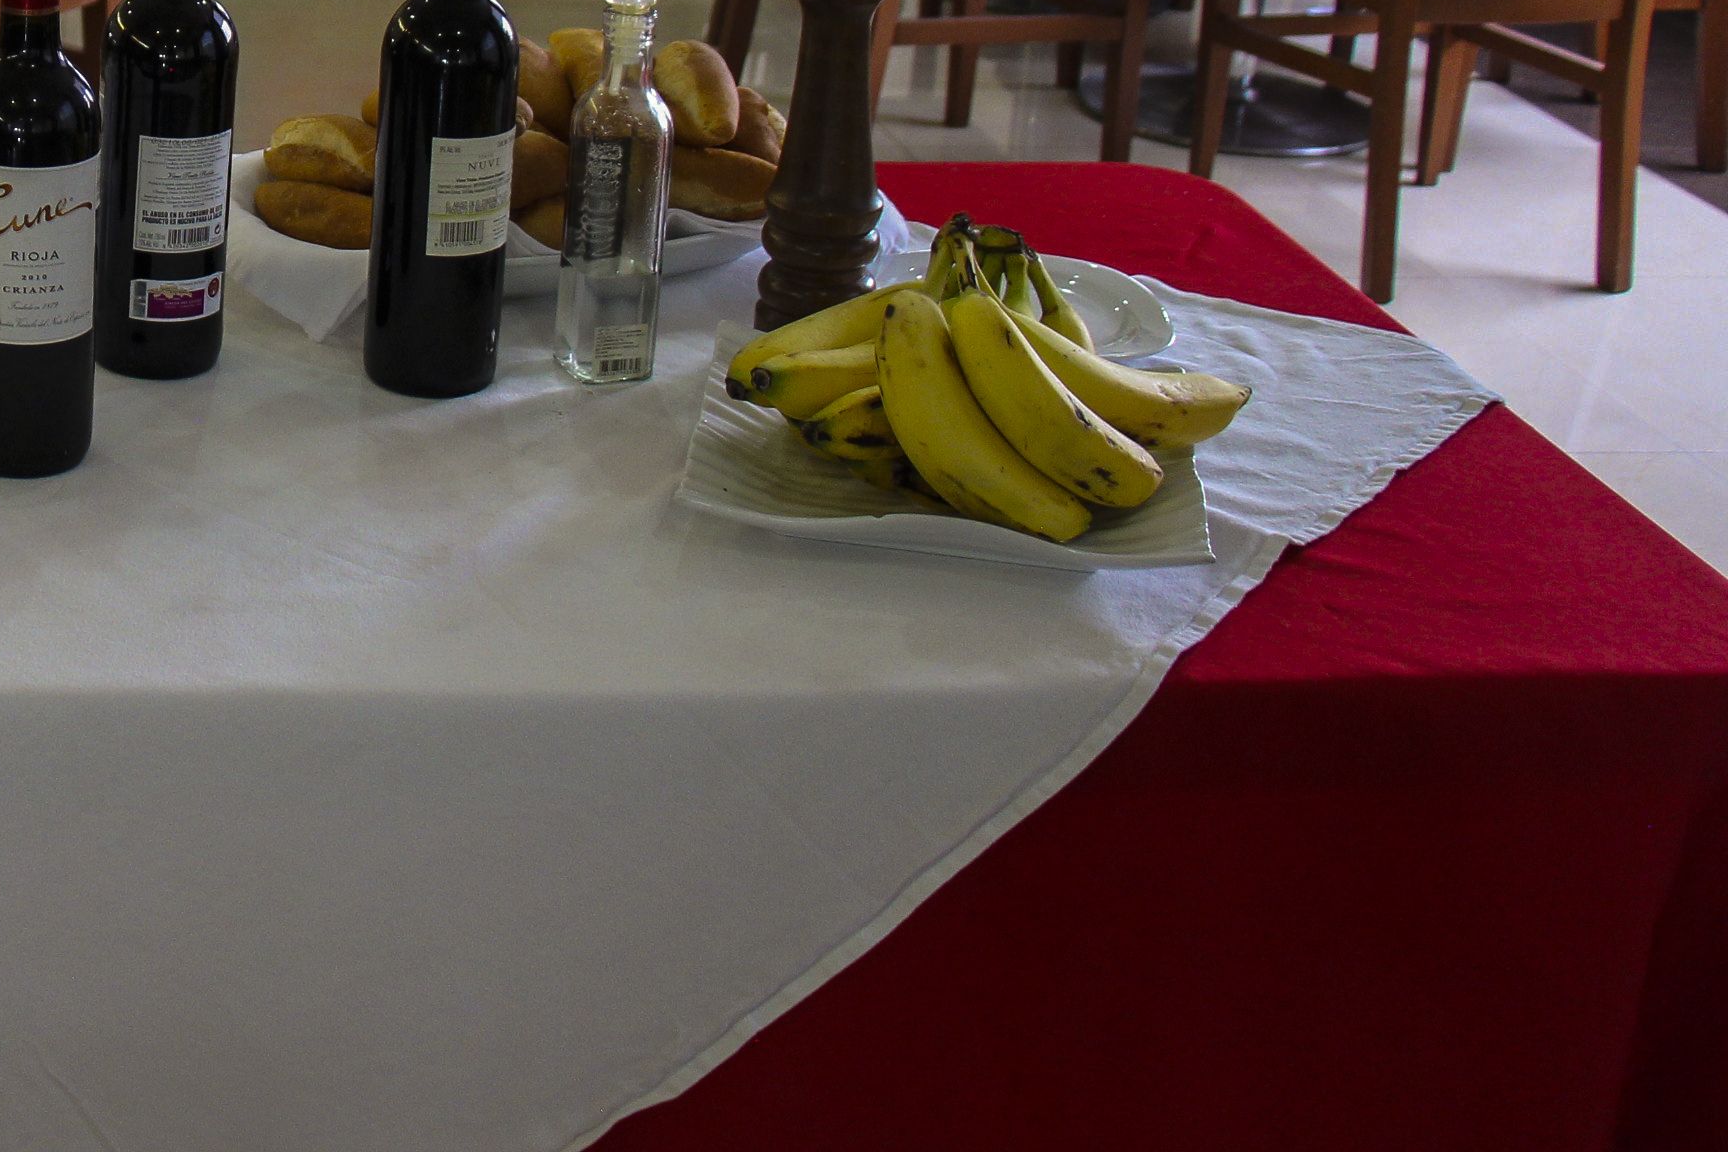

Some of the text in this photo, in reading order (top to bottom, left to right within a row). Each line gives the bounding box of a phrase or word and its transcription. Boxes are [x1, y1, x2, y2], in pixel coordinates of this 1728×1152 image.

[151, 210, 168, 218] ABUSO
[185, 208, 209, 218] CONSUMO
[142, 217, 169, 225] PRODUCTO
[177, 217, 195, 225] NOCIVO
[10, 250, 60, 262] RIOJA
[21, 273, 48, 281] 2010
[2, 284, 65, 295] CRIANZA
